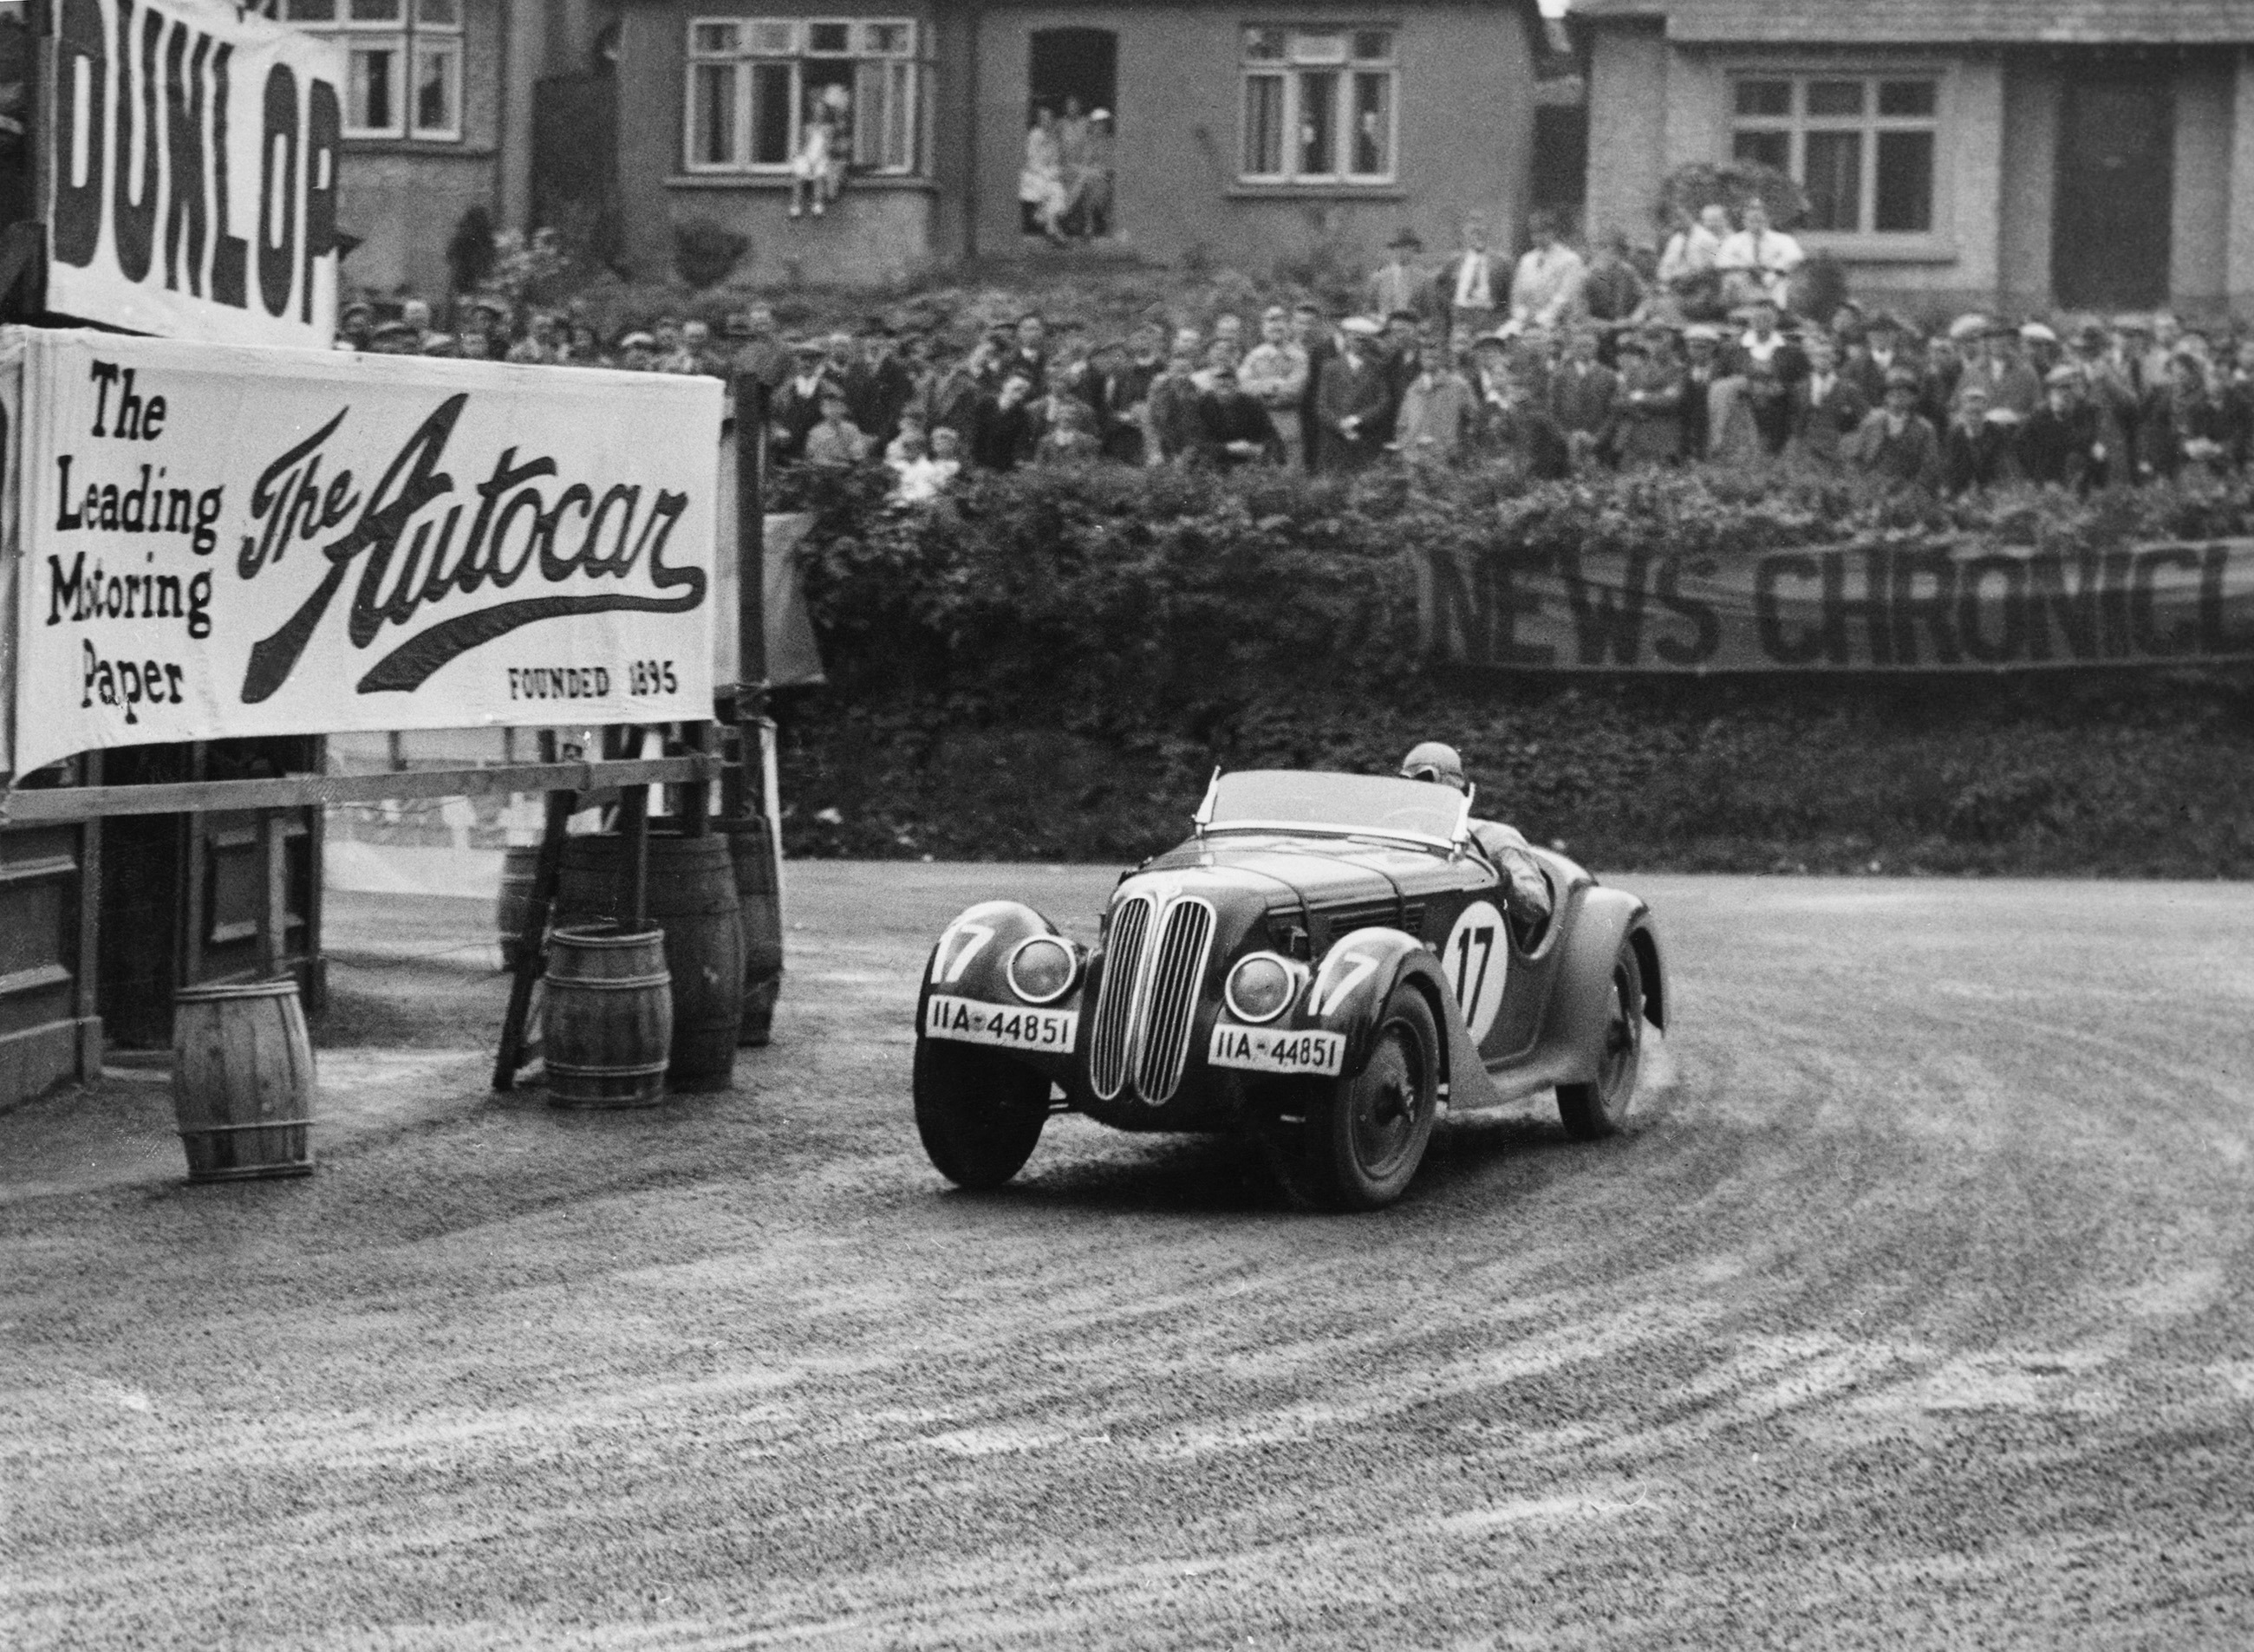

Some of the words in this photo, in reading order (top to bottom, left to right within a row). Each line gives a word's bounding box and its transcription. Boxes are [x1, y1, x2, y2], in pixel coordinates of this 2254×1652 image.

[53, 0, 342, 325] DUNLOP
[92, 359, 166, 440] The
[55, 455, 225, 555] Leading
[238, 405, 361, 580] The
[47, 551, 214, 639] Motoring
[241, 393, 707, 704] Autocar
[1430, 544, 1722, 664] NEWS
[81, 638, 184, 724] Paper
[508, 667, 610, 699] FOUNDED
[629, 660, 678, 695] 1895
[1308, 950, 1379, 1016] 17
[1456, 927, 1494, 1028] 17
